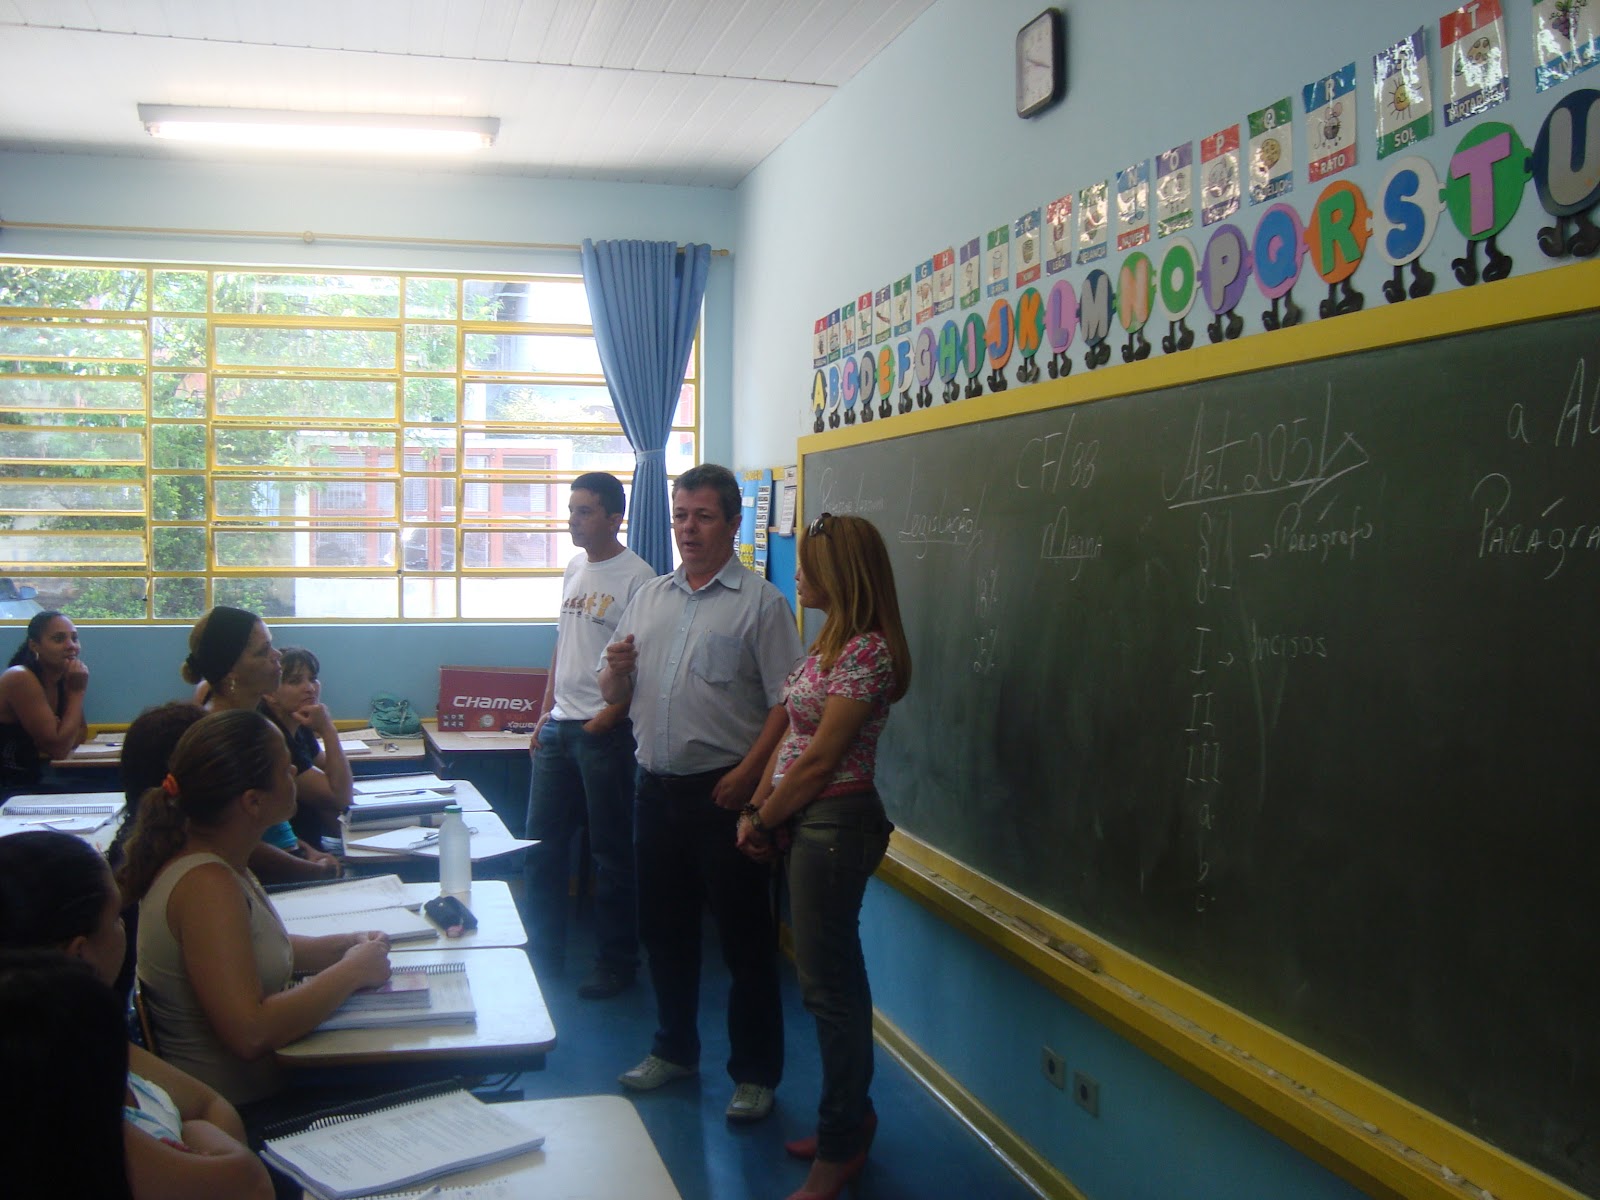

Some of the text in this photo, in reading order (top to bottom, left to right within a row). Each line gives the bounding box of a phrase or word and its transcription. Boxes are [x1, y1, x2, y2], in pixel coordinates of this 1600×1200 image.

[1468, 3, 1480, 29] T
[1325, 78, 1335, 101] R
[1264, 108, 1277, 130] Q
[1216, 134, 1225, 155] P
[1394, 127, 1416, 147] SOL
[1170, 151, 1179, 171] O
[1319, 153, 1345, 175] RATO
[813, 98, 1600, 411] A B C D E F G H I J K L M N O P Q R S T U
[942, 252, 949, 266] H
[921, 264, 928, 278] G
[1243, 417, 1313, 492] 205
